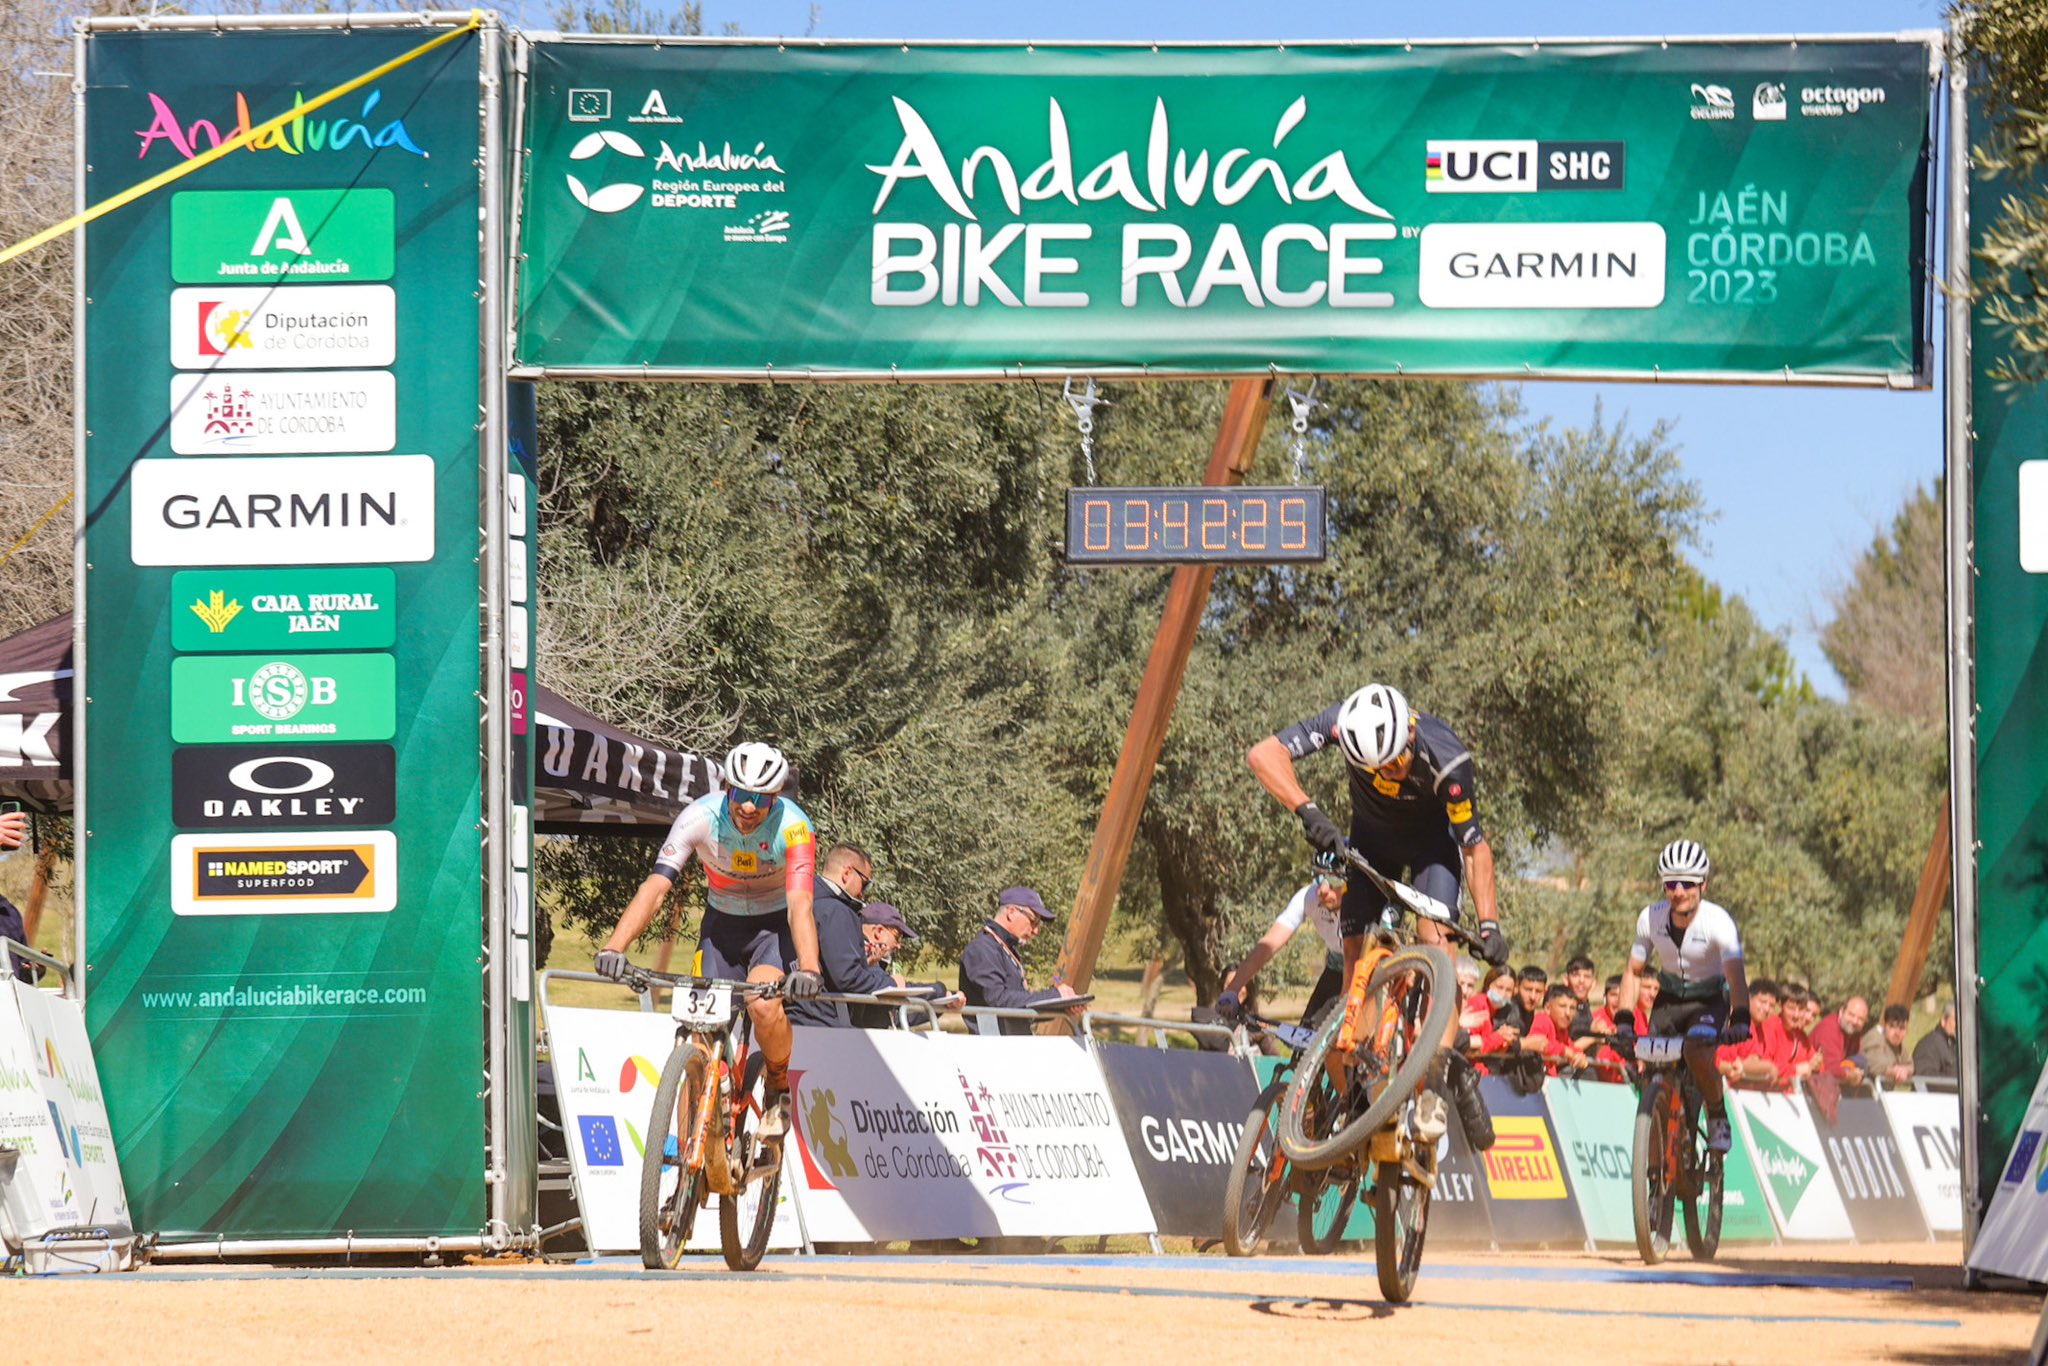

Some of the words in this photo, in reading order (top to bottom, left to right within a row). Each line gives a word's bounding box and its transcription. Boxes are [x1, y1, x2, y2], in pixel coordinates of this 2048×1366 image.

[1801, 85, 1885, 113] octagon
[135, 89, 429, 160] Andalucía
[653, 140, 785, 174] Andalucía
[865, 95, 1395, 220] Andalucía
[1446, 151, 1527, 180] UCI
[1550, 151, 1611, 180] SHC
[652, 179, 700, 194] Región
[763, 180, 785, 192] del
[652, 194, 736, 208] DEPORTE
[1688, 184, 1787, 225] JAÉN
[1402, 226, 1420, 238] BY
[1687, 225, 1877, 267] CÓRDOBA
[217, 262, 258, 275] Junta
[260, 261, 278, 274] de
[280, 259, 350, 274] Andalucía
[871, 223, 1092, 307] BIKE
[1121, 223, 1398, 308] RACE
[1449, 252, 1636, 278] GARMIN
[1687, 269, 1777, 304] 2023
[265, 312, 368, 331] Diputación
[162, 492, 396, 529] GARMIN
[1085, 499, 1307, 550] 03:42:25
[251, 595, 303, 613] CAJA
[308, 593, 379, 611] RURAL
[288, 612, 340, 633] JAÉN
[232, 725, 272, 735] SPORT
[275, 724, 337, 734] BEARINGS
[204, 797, 361, 817] OAKLEY
[225, 860, 342, 876] NAMEDSPORT
[238, 878, 315, 888] SUPERFOOD
[142, 985, 426, 1009] www.andaluciabikerace.com
[688, 991, 716, 1015] 3-2
[850, 1099, 959, 1146] Diputación
[999, 1092, 1111, 1128] AYUNTAMIENTO
[864, 1147, 888, 1179] de
[892, 1145, 973, 1179] Córdoba
[1015, 1144, 1041, 1179] DE
[1036, 1144, 1111, 1179] CORDOBA
[1484, 1133, 1553, 1181] PIRELLI
